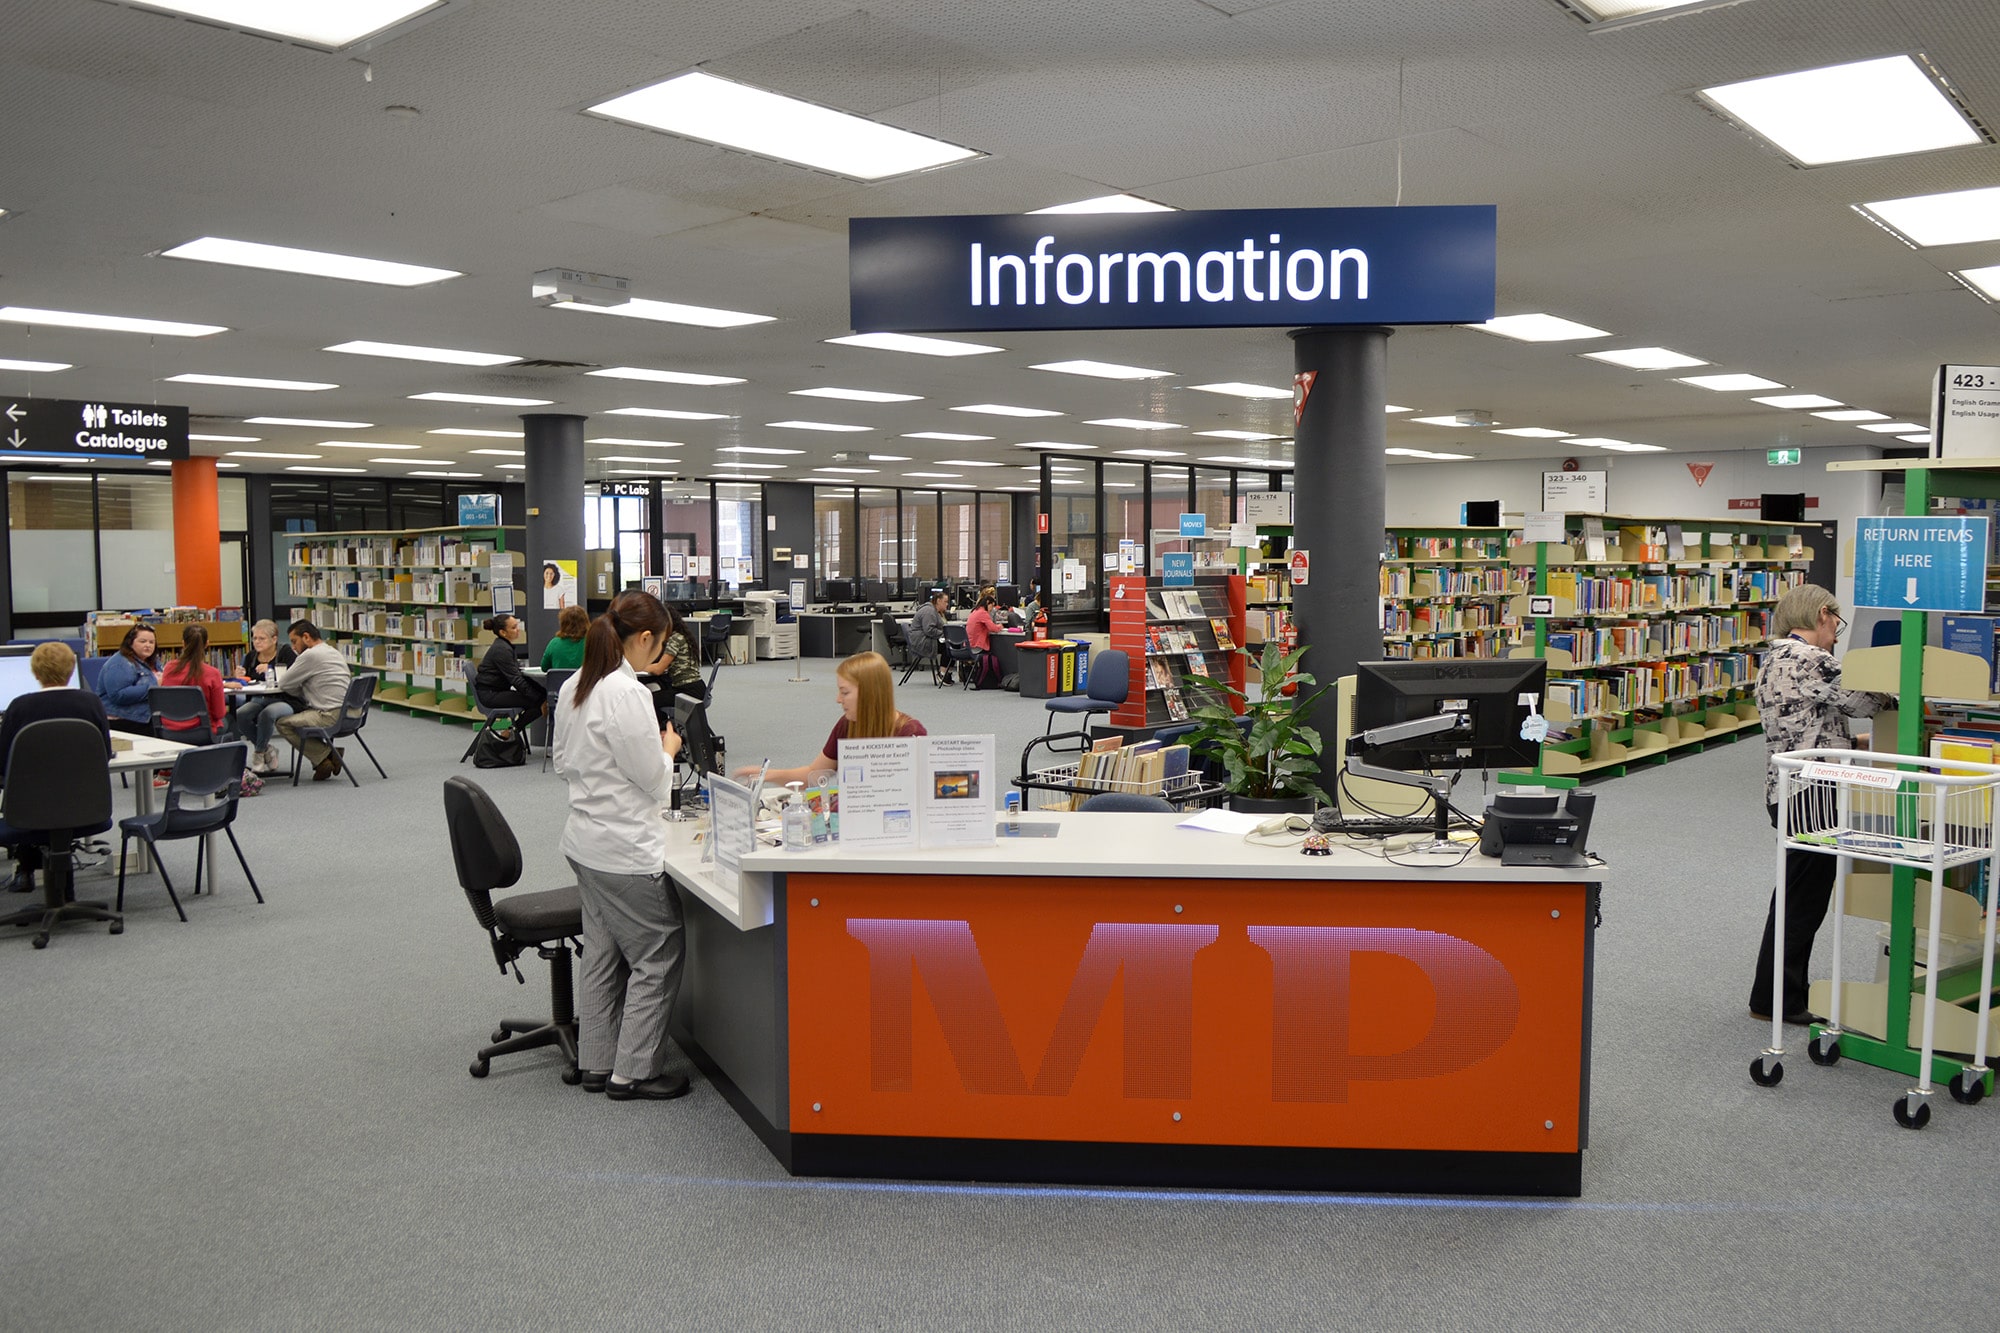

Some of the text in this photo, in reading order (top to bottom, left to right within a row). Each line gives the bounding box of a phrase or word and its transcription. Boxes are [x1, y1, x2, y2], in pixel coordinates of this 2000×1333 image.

[970, 233, 1369, 306] Information
[1953, 374, 1984, 388] 423
[111, 409, 168, 427] Toilets
[76, 431, 168, 452] Catalogue
[614, 484, 650, 496] PC Labs
[1740, 499, 1754, 507] Fire
[1864, 528, 1974, 542] RETURN ITEMS
[1894, 554, 1933, 568] HERE
[1164, 570, 1192, 578] JOURNALS
[1434, 665, 1476, 680] DELL
[1814, 767, 1888, 784] Items for Return
[846, 918, 1521, 1103] MP
